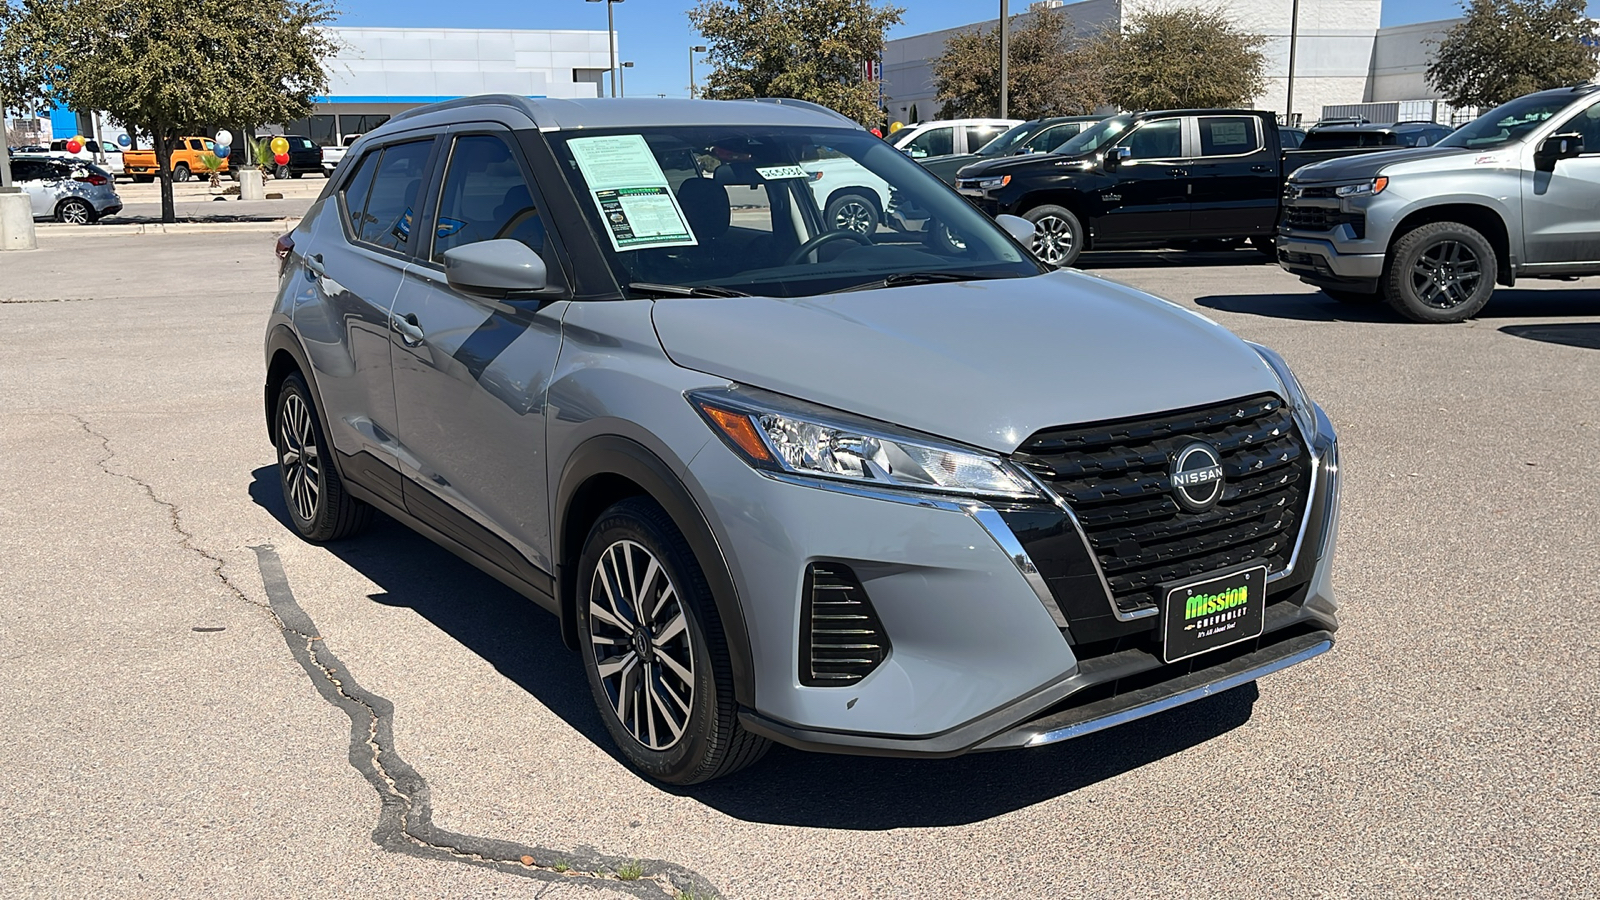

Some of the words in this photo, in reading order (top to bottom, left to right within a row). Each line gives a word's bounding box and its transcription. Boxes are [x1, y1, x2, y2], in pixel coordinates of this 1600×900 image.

[1173, 467, 1223, 485] NISSAN
[1185, 585, 1248, 620] Mission
[1196, 606, 1248, 629] CHEVROLET
